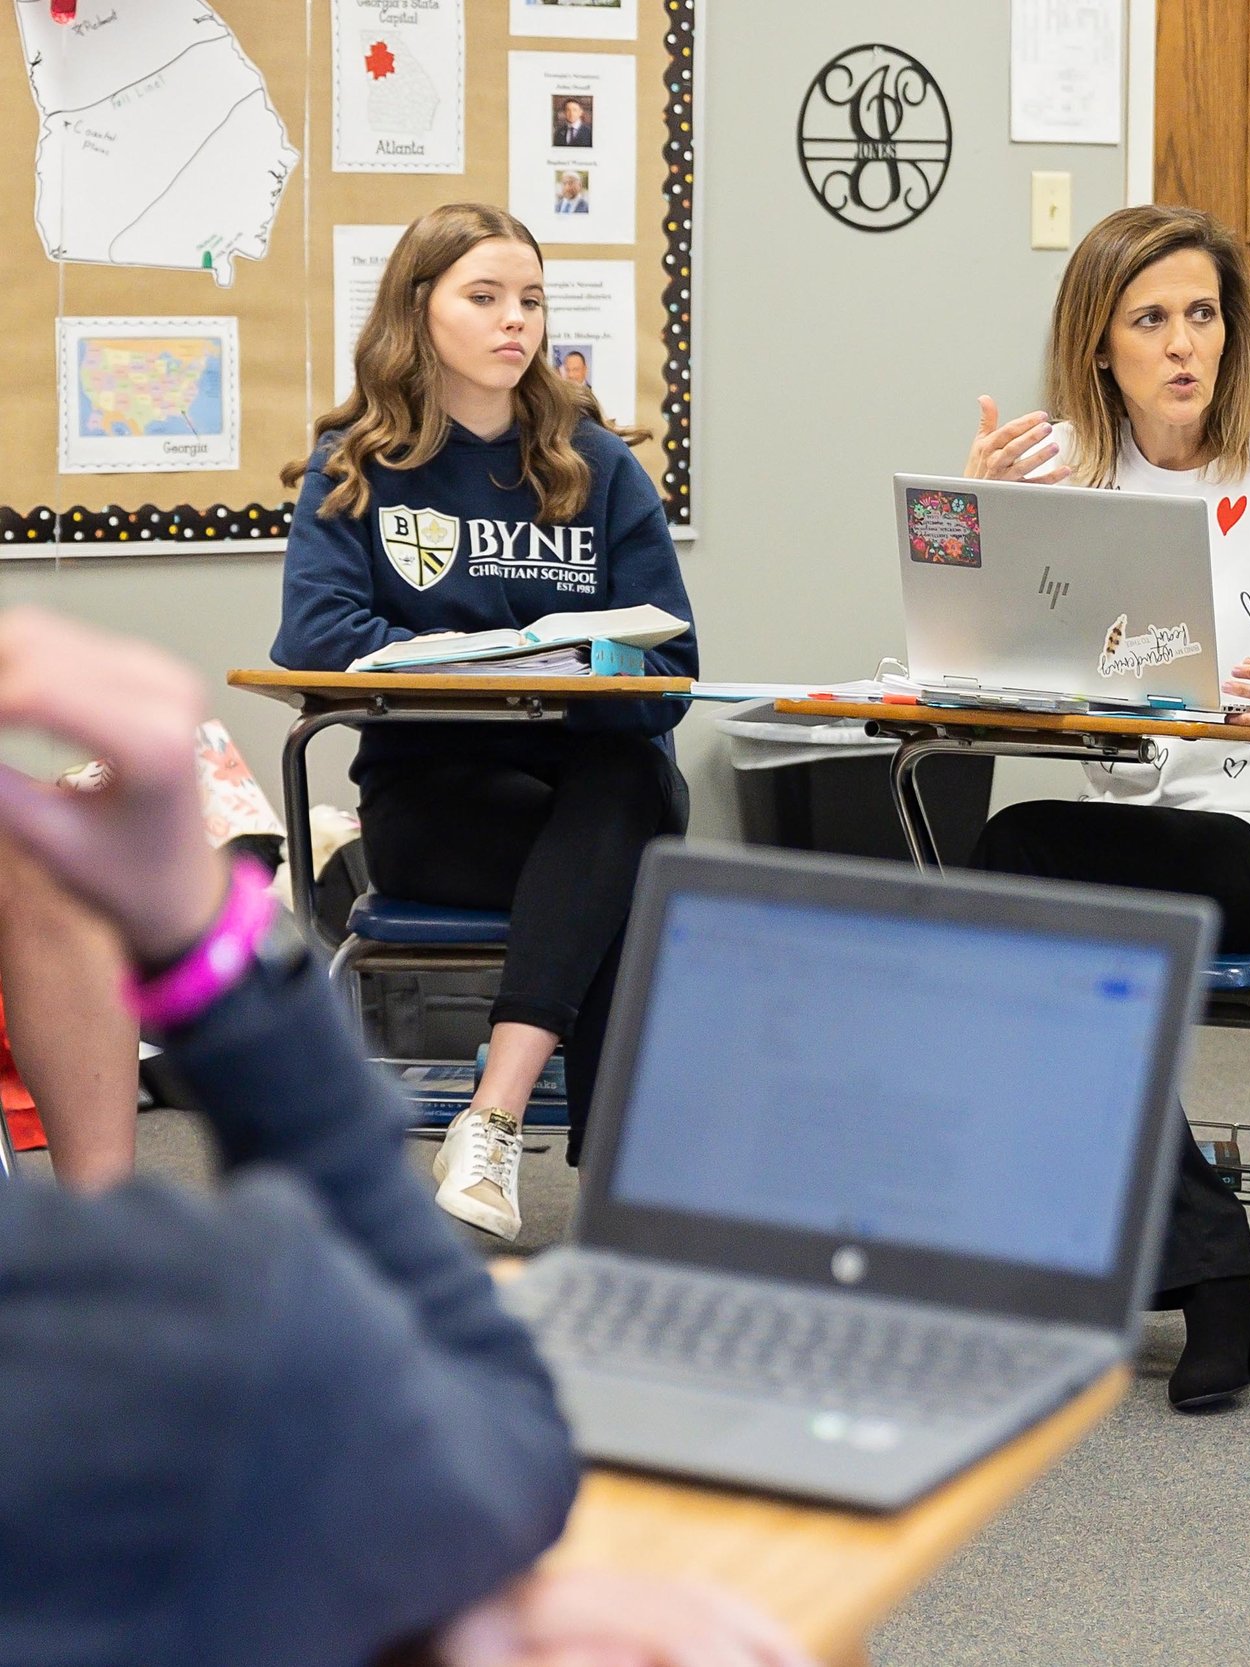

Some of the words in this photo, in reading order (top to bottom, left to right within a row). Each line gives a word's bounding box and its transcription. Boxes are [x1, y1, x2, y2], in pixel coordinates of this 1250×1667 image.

[379, 12, 418, 27] Capital
[376, 140, 425, 155] Atlanta
[854, 141, 897, 161] JONES
[163, 441, 208, 457] Georgia
[394, 515, 409, 536] B
[466, 519, 597, 565] BYNE
[540, 567, 597, 584] SCHOOL
[556, 582, 575, 592] EST.
[576, 585, 596, 594] 1983
[1038, 566, 1069, 609] hp
